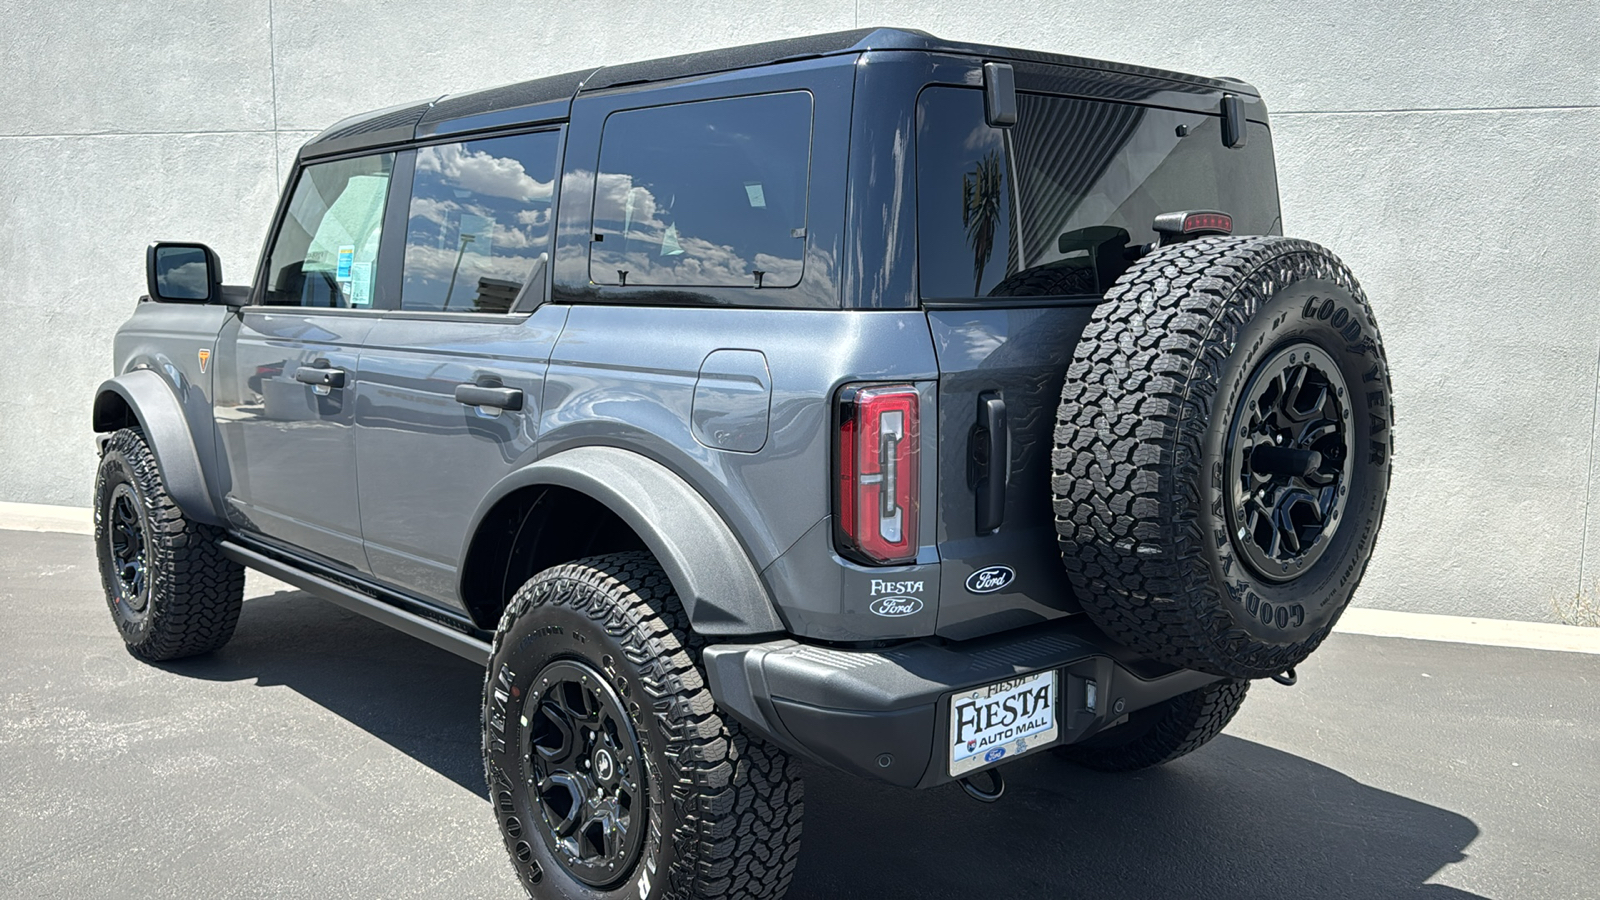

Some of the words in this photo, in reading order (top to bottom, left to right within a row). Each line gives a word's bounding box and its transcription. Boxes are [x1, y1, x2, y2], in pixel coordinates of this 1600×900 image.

[1223, 332, 1265, 426] TERRITORY
[1272, 311, 1287, 331] RT
[870, 579, 924, 596] FIESTA
[976, 570, 1006, 590] Ford
[879, 598, 914, 614] Ford
[954, 684, 1051, 746] FIESTA
[978, 728, 1013, 748] AUTO
[1016, 717, 1048, 735] MALL
